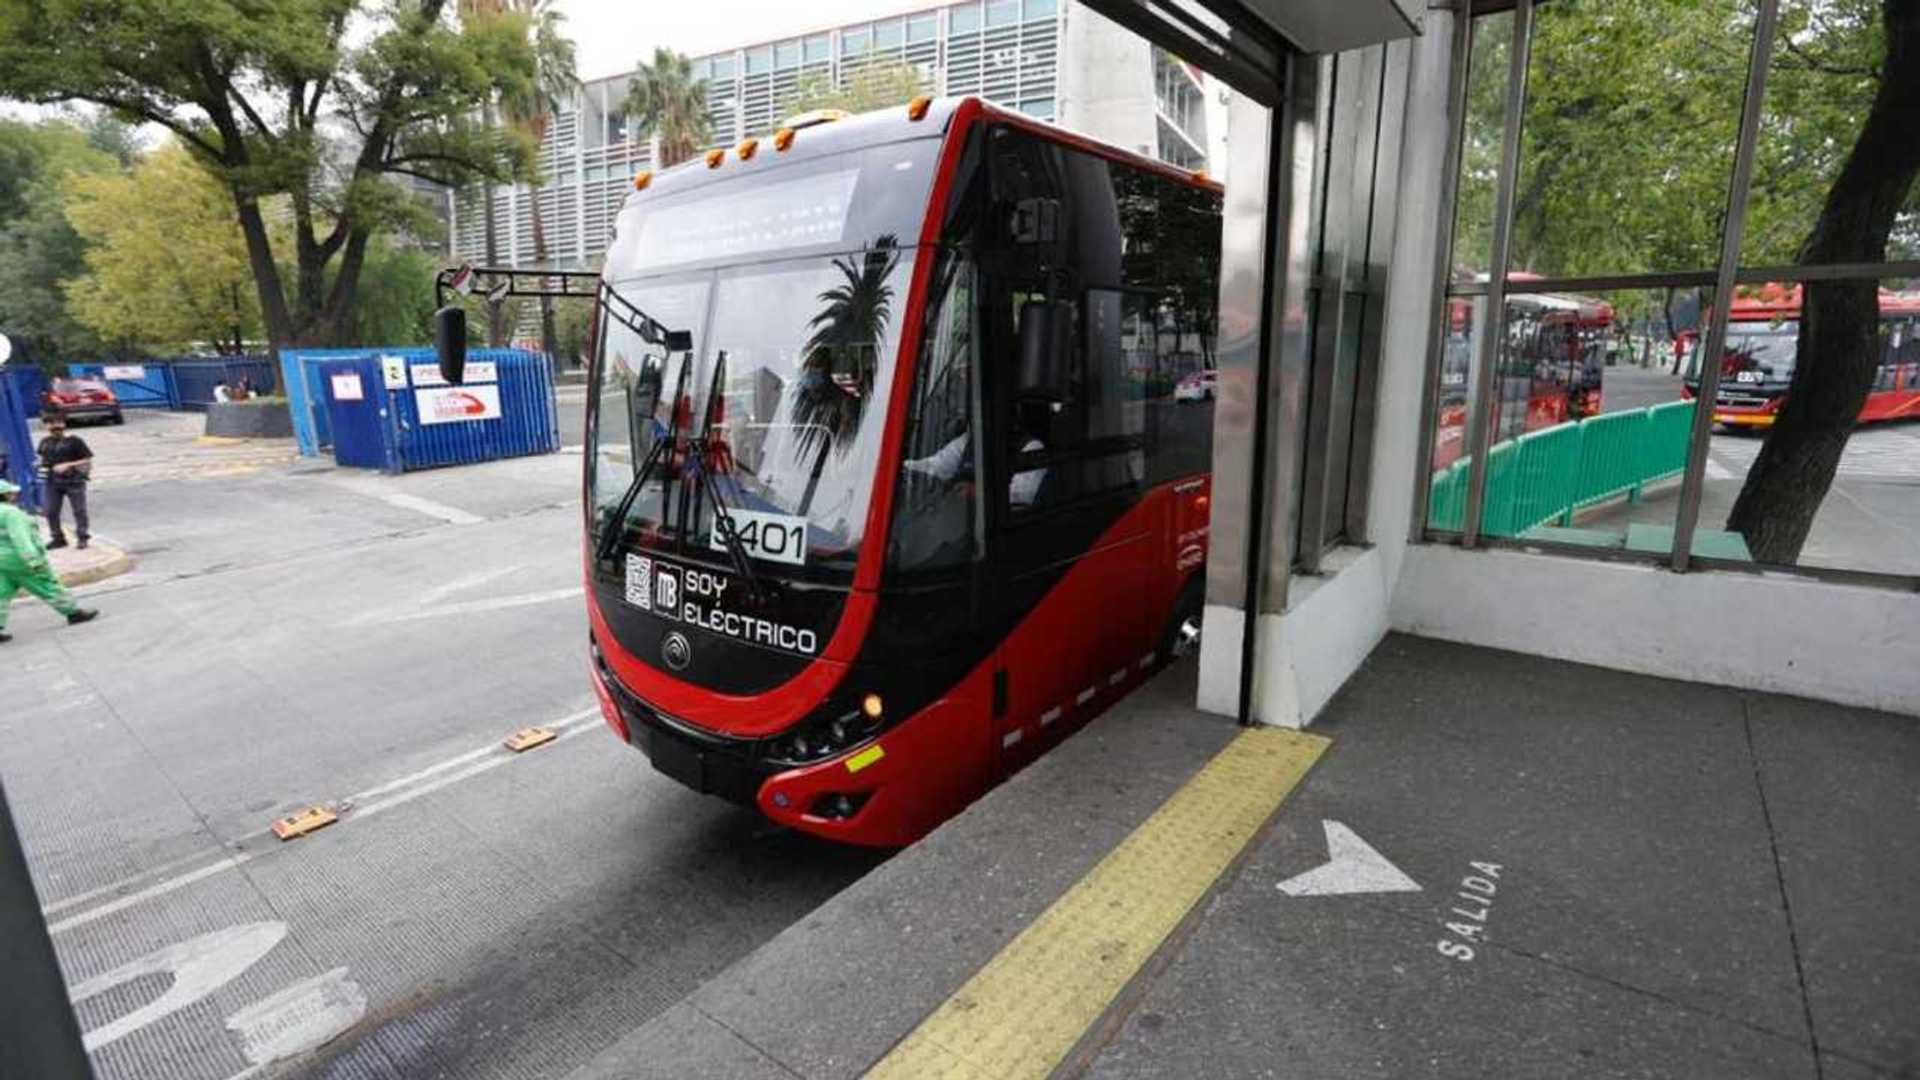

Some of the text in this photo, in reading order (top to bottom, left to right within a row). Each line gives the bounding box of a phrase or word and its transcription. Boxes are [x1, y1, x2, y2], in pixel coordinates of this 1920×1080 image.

[685, 570, 728, 599] SOY
[683, 601, 817, 653] ELÉCTRICO
[1437, 861, 1503, 961] SALIDA
